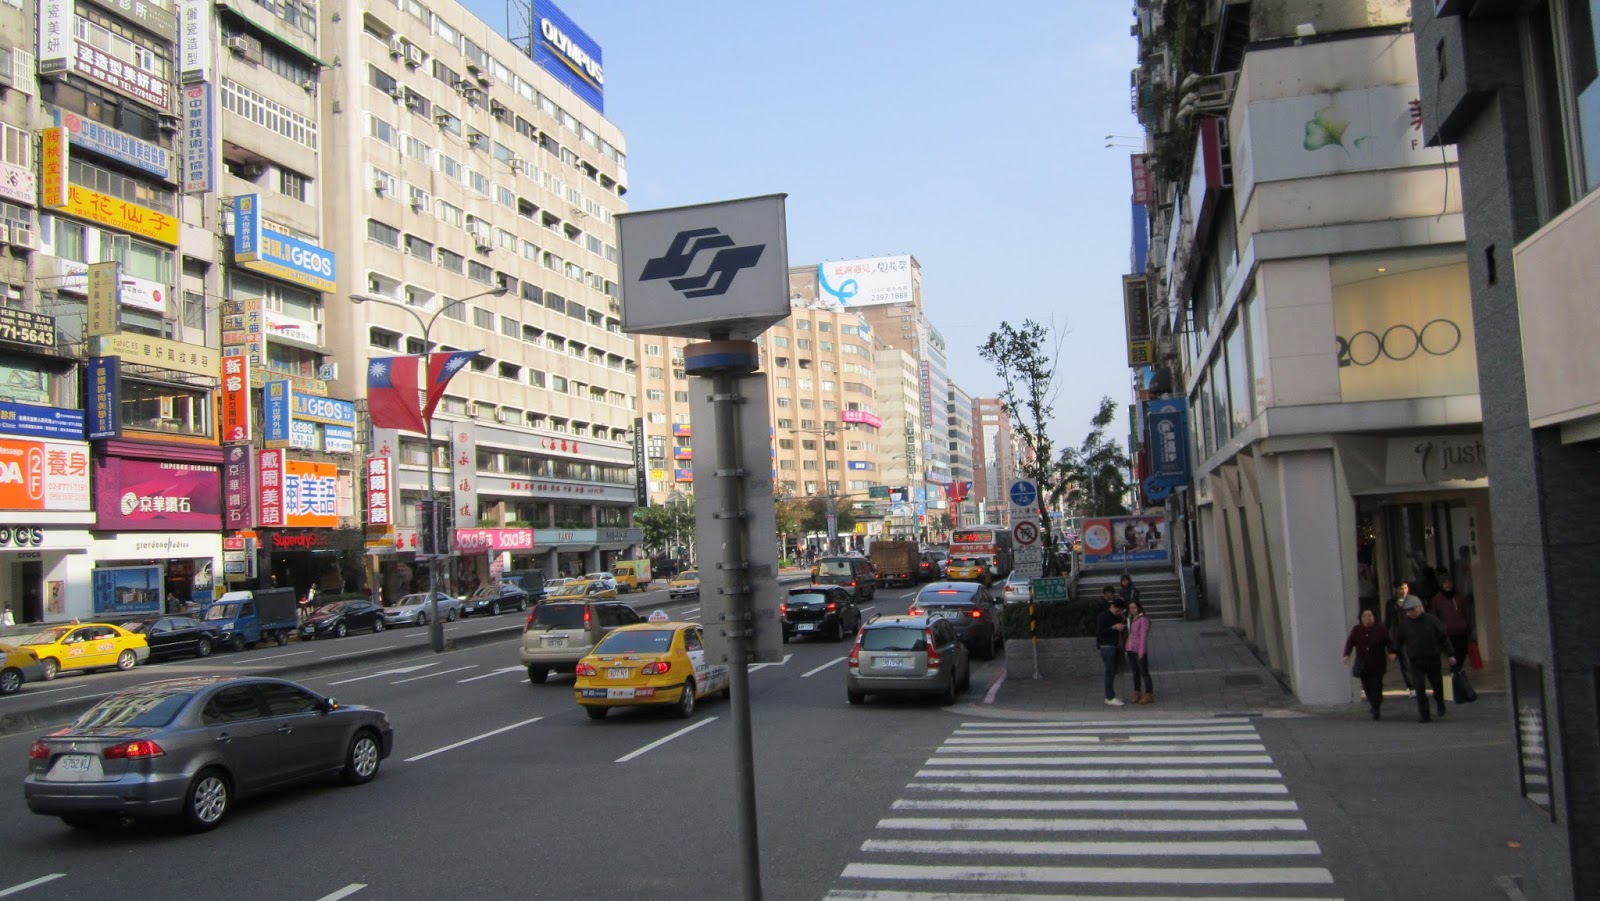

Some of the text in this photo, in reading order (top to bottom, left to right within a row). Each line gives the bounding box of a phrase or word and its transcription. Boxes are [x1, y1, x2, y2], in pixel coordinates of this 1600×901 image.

[541, 17, 604, 84] OLYMPUS
[291, 246, 331, 277] GEOS
[0, 323, 54, 346] 71-5643
[1335, 319, 1461, 368] 2000
[308, 398, 342, 420] GEOS
[292, 421, 314, 434] GEOS
[47, 449, 88, 477] 養身
[229, 464, 241, 522] 京華鑽石
[261, 452, 280, 524] 戴爾美語
[369, 459, 387, 524] 戴爾美語
[139, 496, 191, 513] 京華鑽石
[17, 551, 41, 559] crocs
[272, 533, 311, 549] Superdry
